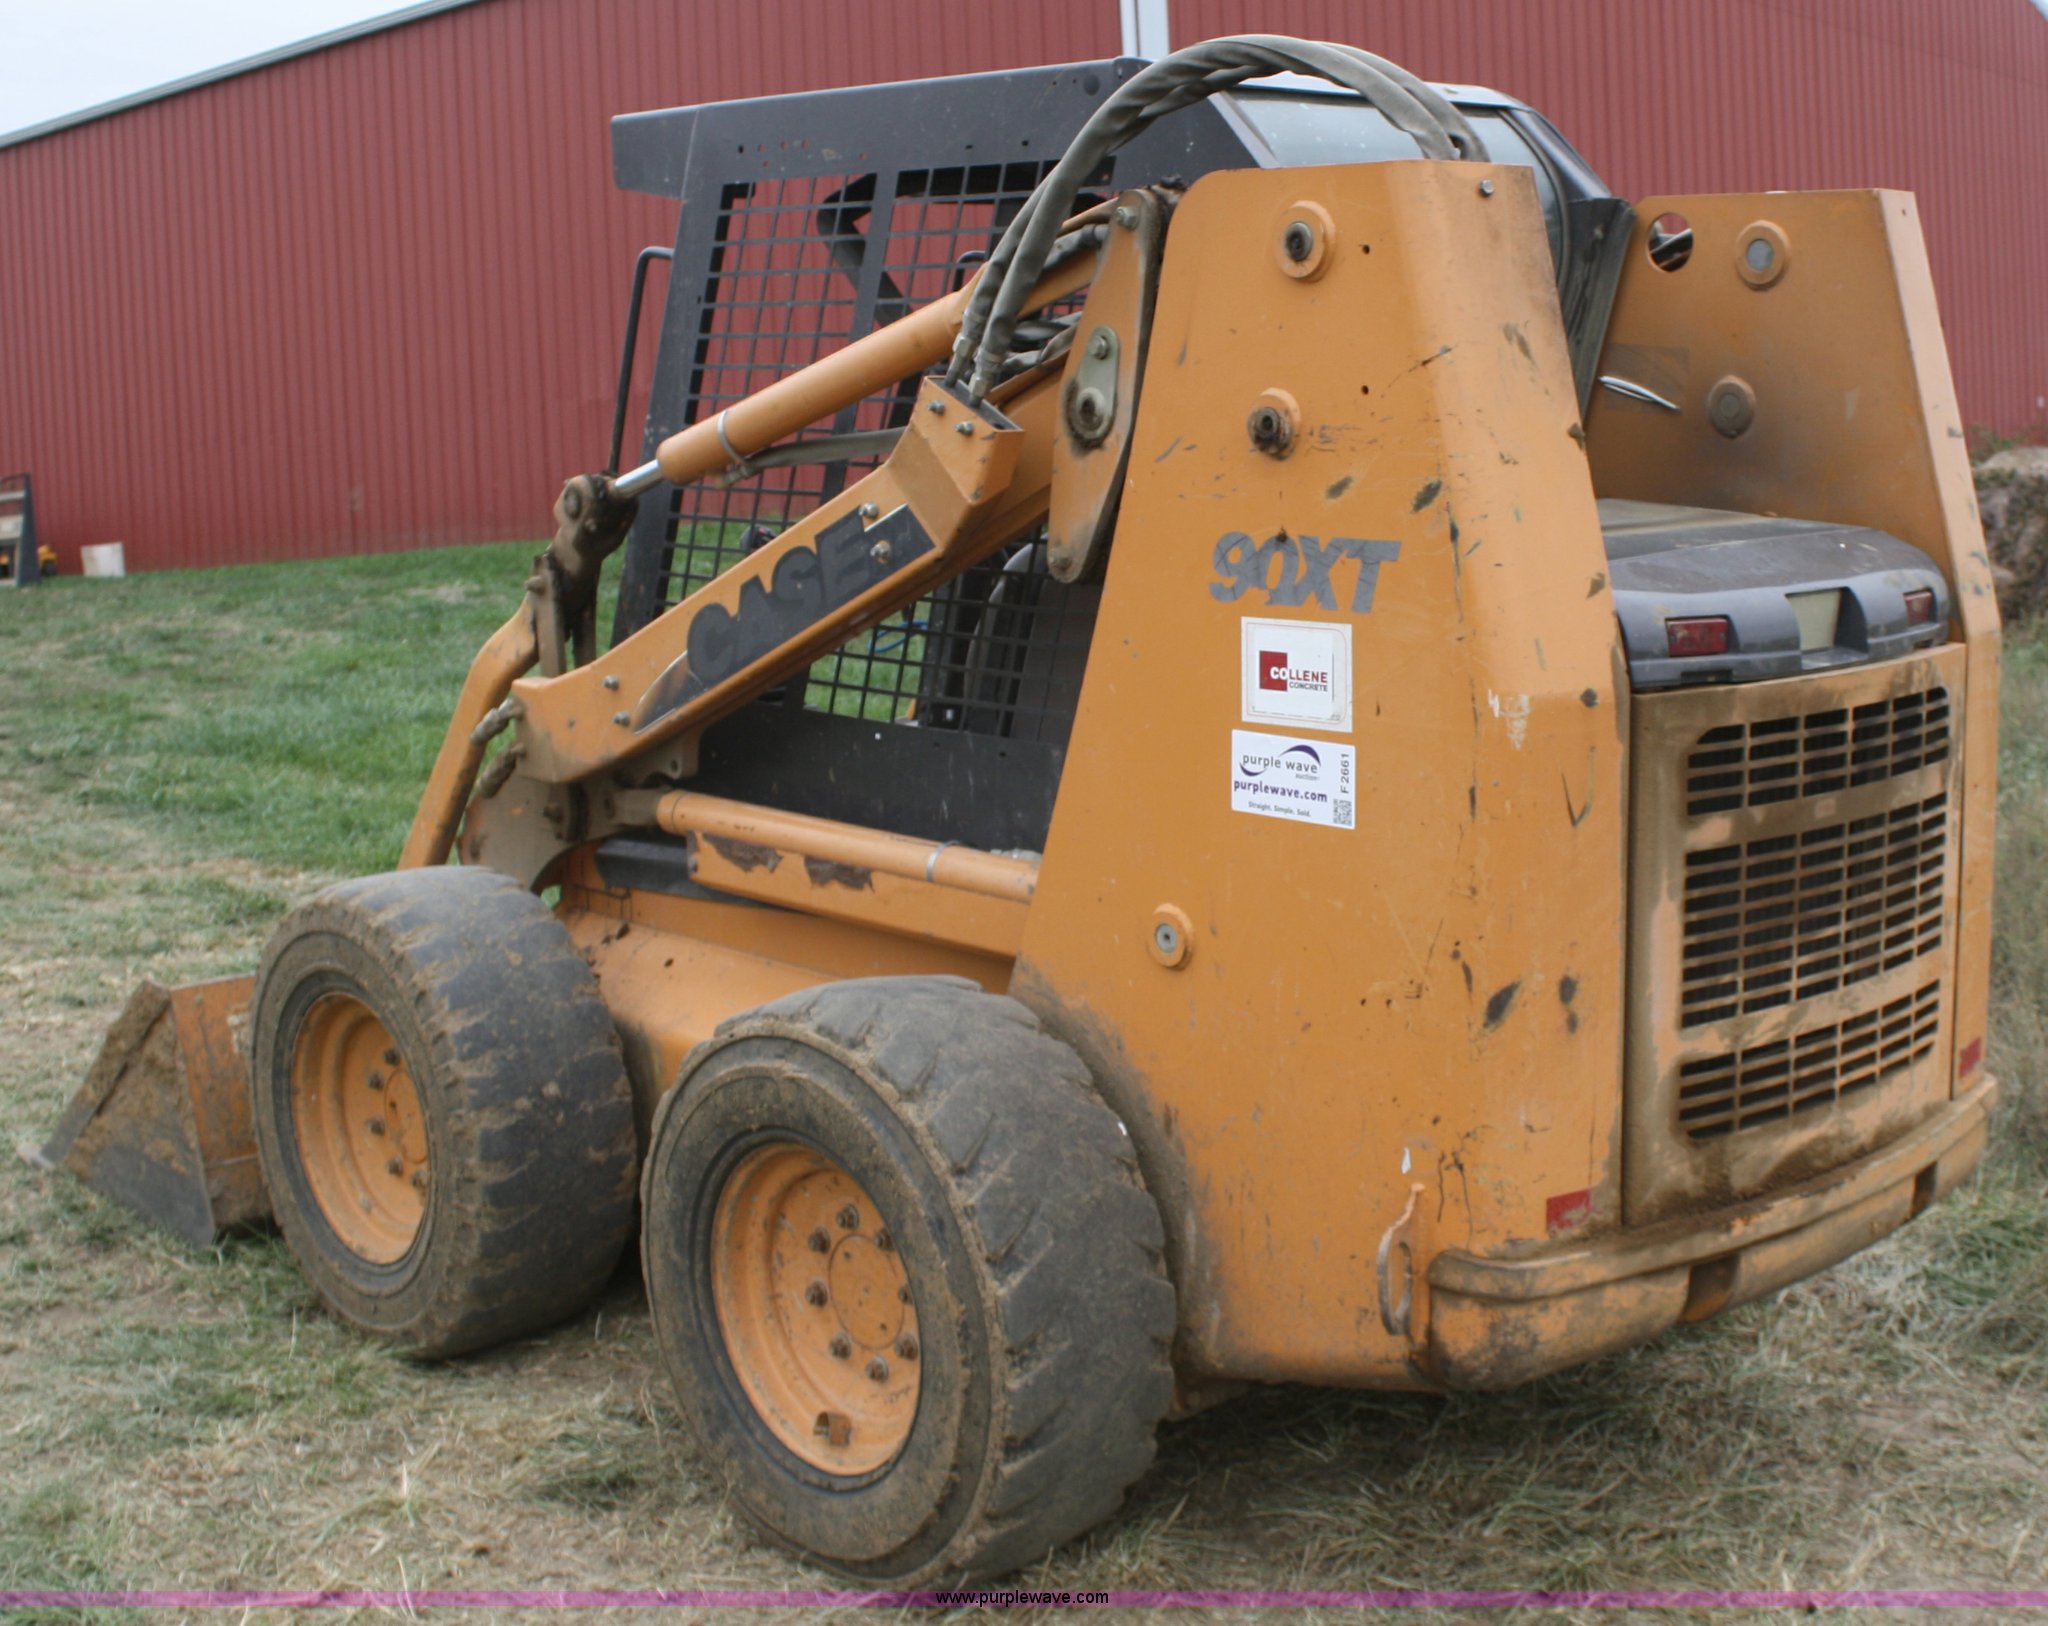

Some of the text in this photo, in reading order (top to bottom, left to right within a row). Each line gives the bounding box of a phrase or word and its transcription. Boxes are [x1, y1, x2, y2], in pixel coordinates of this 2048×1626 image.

[1208, 531, 1401, 613] 90XT
[687, 504, 880, 685] CASE
[1270, 666, 1328, 683] COLLENE
[1289, 681, 1328, 692] CONCRETE
[1242, 754, 1318, 774] purple wave
[1233, 779, 1328, 803] purplewave.com
